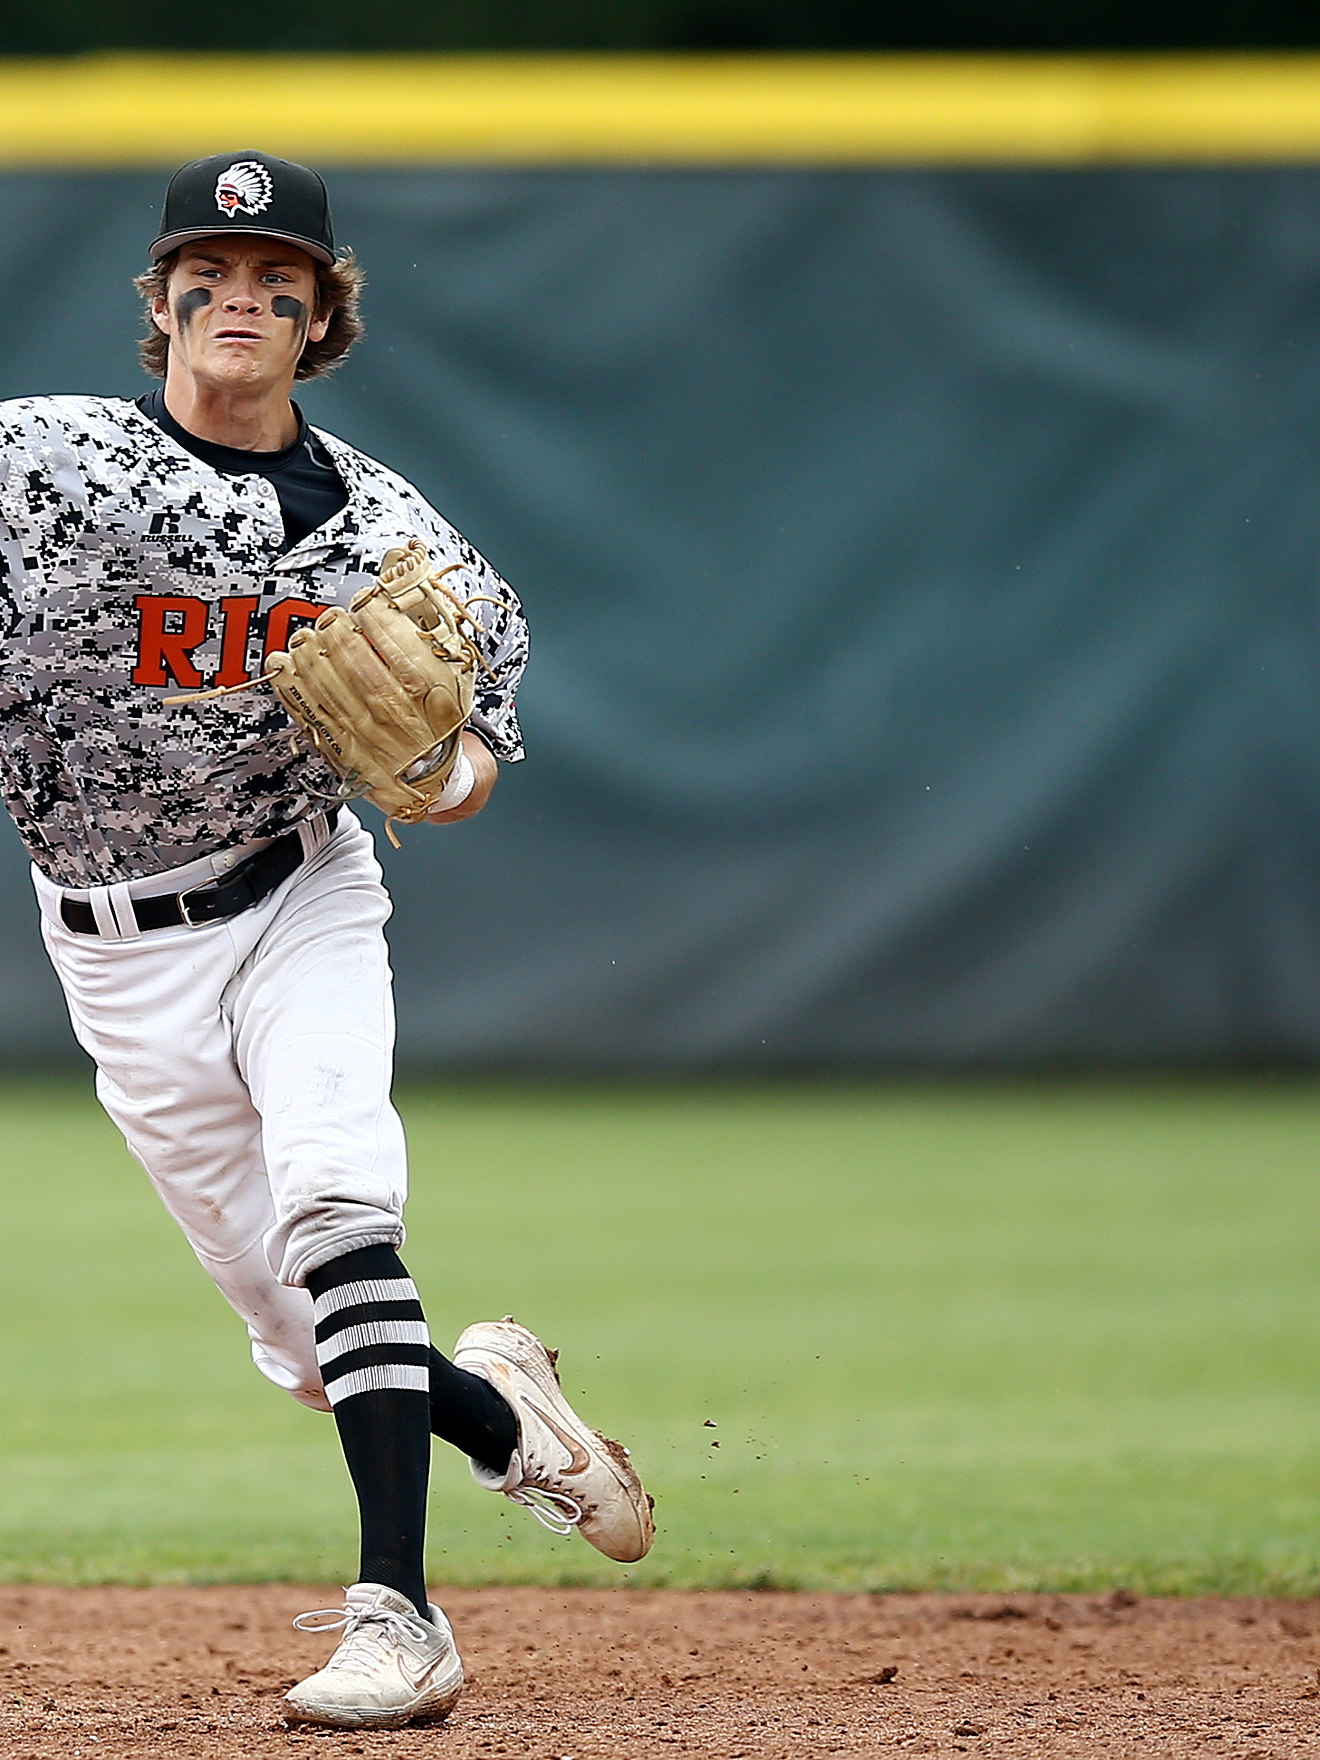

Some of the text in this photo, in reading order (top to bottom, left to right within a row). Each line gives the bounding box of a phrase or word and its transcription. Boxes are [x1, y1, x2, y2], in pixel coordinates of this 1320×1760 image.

[140, 534, 195, 543] RUSSELL
[289, 685, 302, 701] THE
[300, 701, 316, 720] GOLD
